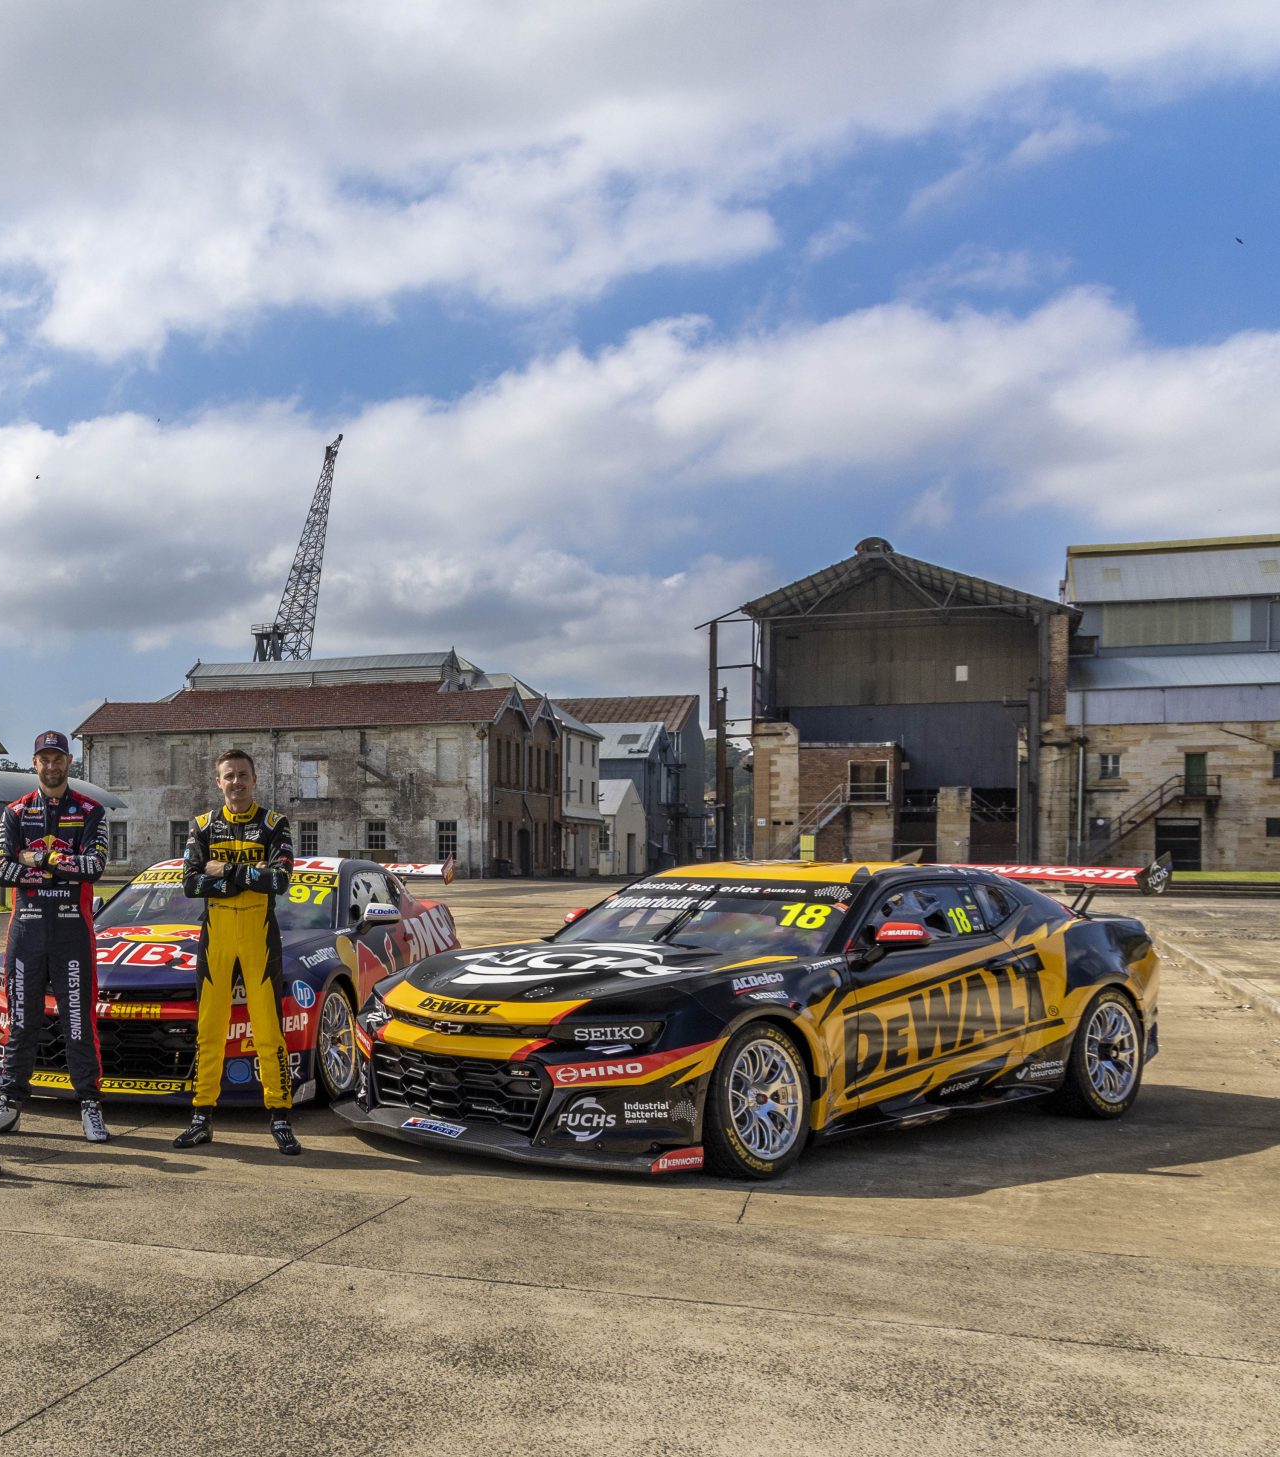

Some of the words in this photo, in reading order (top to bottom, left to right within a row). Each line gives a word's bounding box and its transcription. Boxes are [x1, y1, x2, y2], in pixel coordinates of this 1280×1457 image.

[210, 849, 264, 861] DEWALT
[1147, 868, 1168, 887] FUCHS
[288, 885, 333, 905] 97
[627, 883, 688, 892] Industrial
[687, 883, 761, 894] Bateries
[779, 902, 832, 930] 18
[947, 907, 972, 934] 18
[810, 956, 842, 970] DUNLOP
[67, 960, 80, 987] GIVES
[732, 972, 784, 992] ACDelco
[15, 971, 25, 1029] AMPLIFY
[68, 988, 80, 1007] YOU
[110, 1003, 161, 1019] SUPER
[417, 996, 501, 1016] DEWALT
[70, 1007, 81, 1040] WINGS
[842, 953, 1047, 1090] DEWALT
[574, 1025, 645, 1042] SEIKO
[580, 1062, 643, 1078] HINO
[1030, 1060, 1064, 1071] Credence
[1030, 1066, 1065, 1079] Insurance
[102, 1080, 182, 1092] STORAGE
[624, 1101, 670, 1110] Industrial
[557, 1113, 617, 1127] FUCHS
[624, 1110, 669, 1119] Batteries
[667, 1157, 703, 1167] KENWORTH
